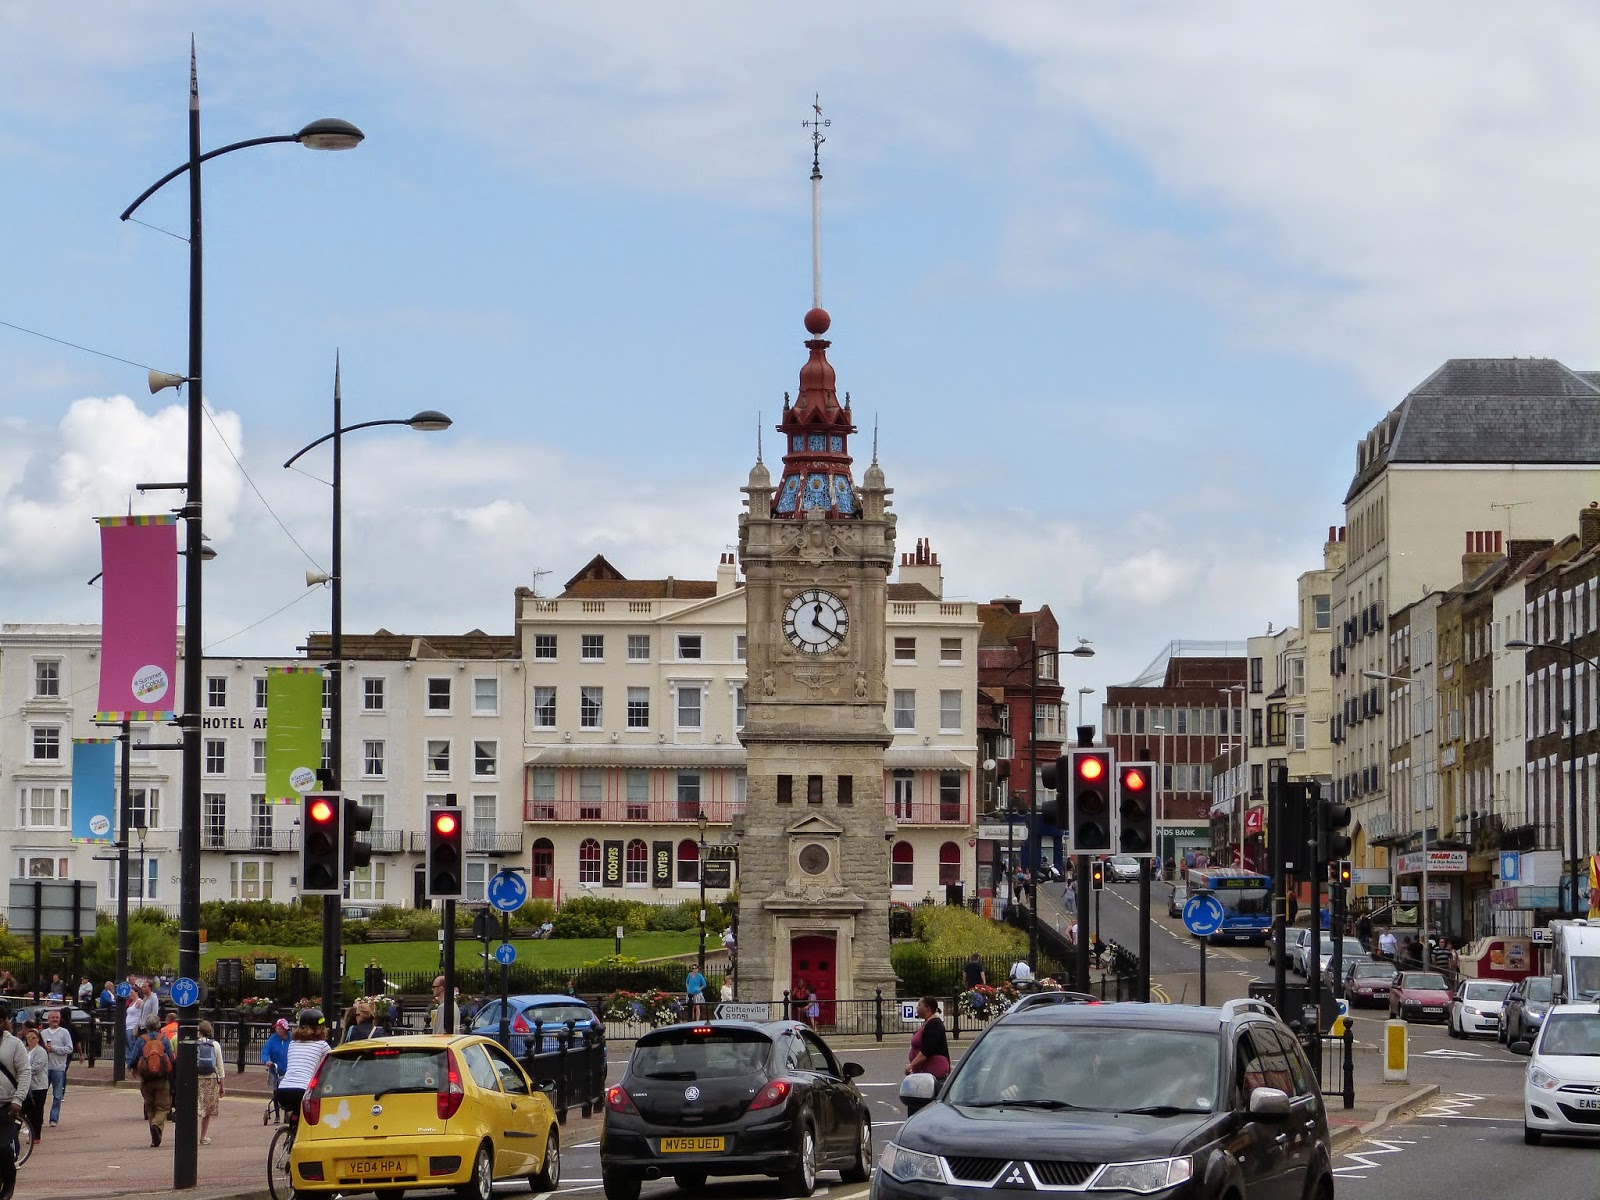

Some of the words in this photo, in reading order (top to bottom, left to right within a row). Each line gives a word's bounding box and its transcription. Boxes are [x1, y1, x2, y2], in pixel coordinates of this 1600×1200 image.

[202, 717, 245, 729] HOTEL
[1155, 829, 1173, 837] OYDS
[1175, 829, 1195, 837] BANK
[607, 847, 619, 881] SEAFOOD
[657, 850, 668, 878] GELATO
[1250, 879, 1260, 888] 32
[725, 1005, 766, 1013] Cliftonville
[665, 1139, 695, 1150] MV59
[697, 1138, 720, 1149] UED
[350, 1162, 378, 1173] YE04
[380, 1161, 402, 1172] HPA
